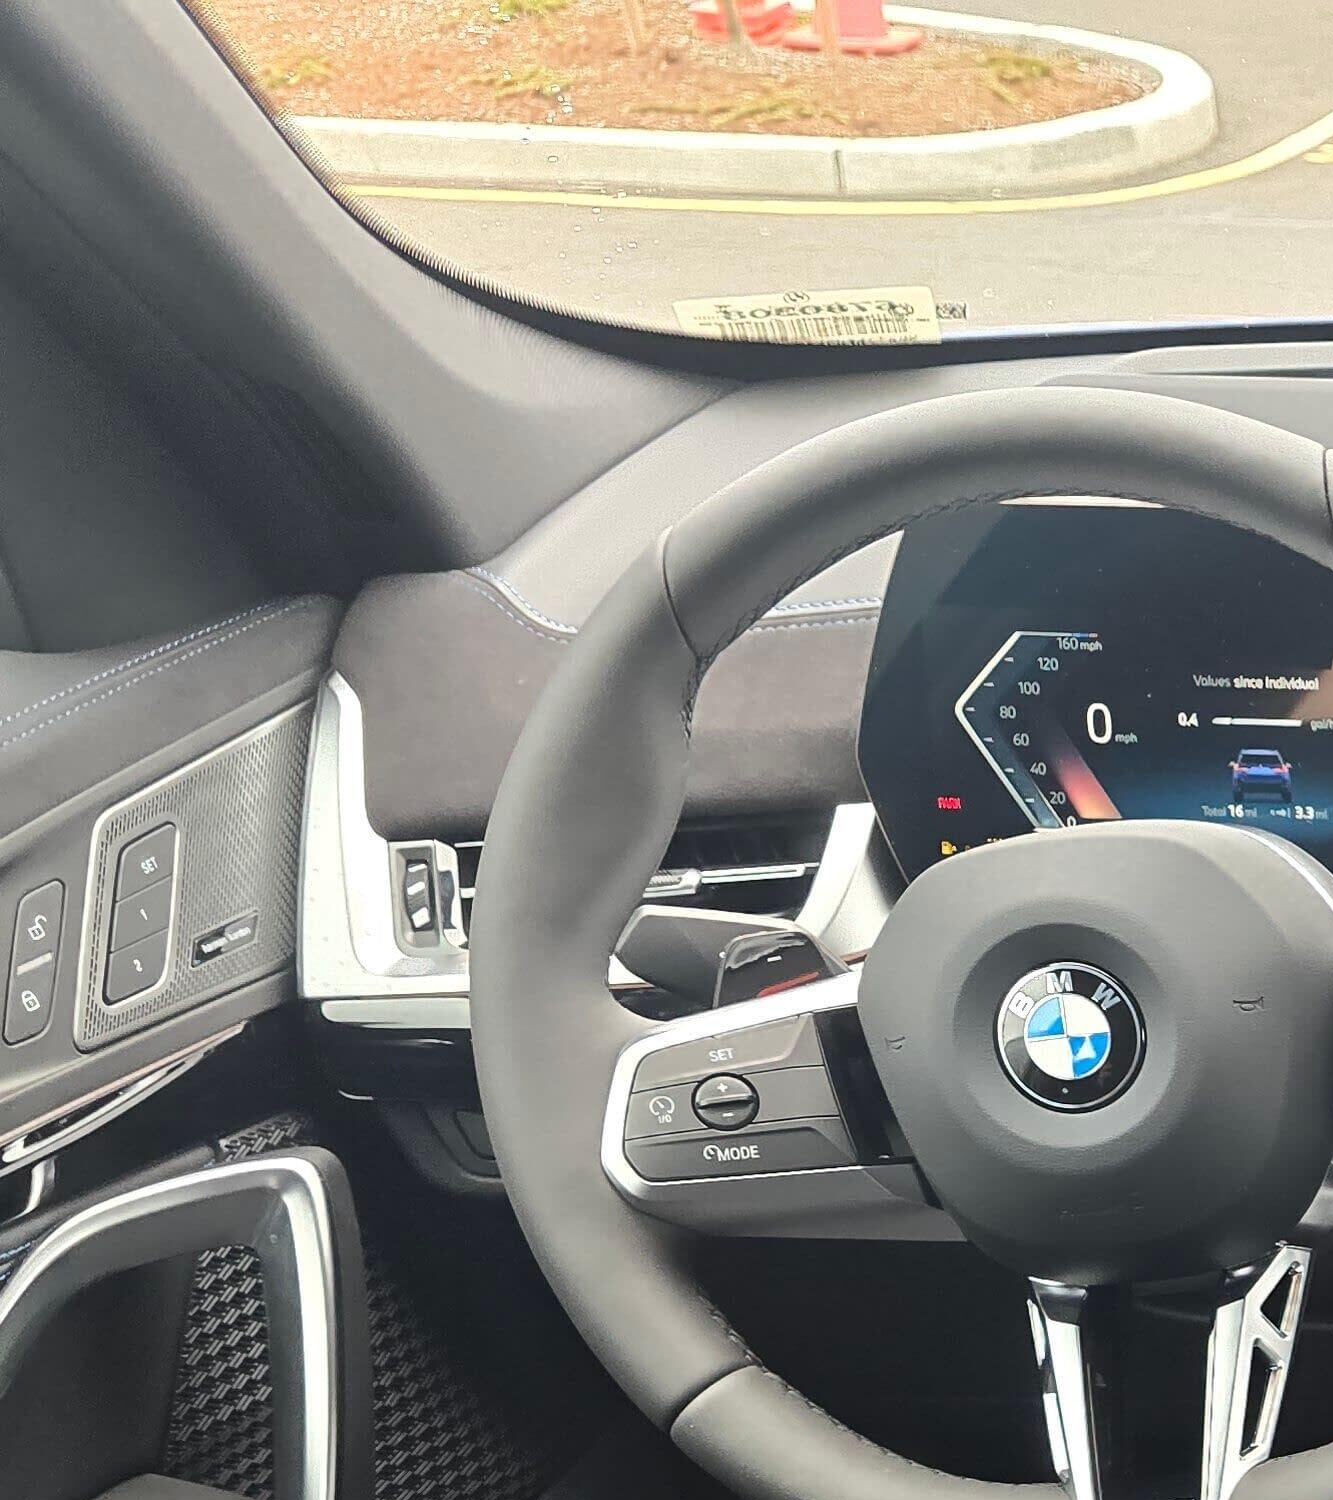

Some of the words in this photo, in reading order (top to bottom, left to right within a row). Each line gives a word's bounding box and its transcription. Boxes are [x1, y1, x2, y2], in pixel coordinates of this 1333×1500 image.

[1057, 637, 1079, 650] 160
[1079, 640, 1102, 652] mph
[1037, 657, 1059, 671] 120
[1018, 681, 1040, 695] 100
[1193, 674, 1231, 688] Values
[1233, 676, 1263, 689] since
[1000, 705, 1016, 719] 80
[1086, 702, 1113, 744] 0
[1115, 733, 1138, 745] mph
[1013, 732, 1029, 746] 60
[1030, 762, 1046, 776] 40
[1049, 791, 1066, 805] 20
[1201, 805, 1227, 817] Total
[1227, 804, 1244, 818] 16
[1294, 805, 1314, 820] 3.3
[1066, 815, 1077, 827] 0
[141, 856, 158, 875] SET
[140, 908, 148, 921] 1
[1009, 971, 1122, 1019] BMW
[709, 1048, 734, 1062] SET
[718, 1145, 760, 1161] MODE
